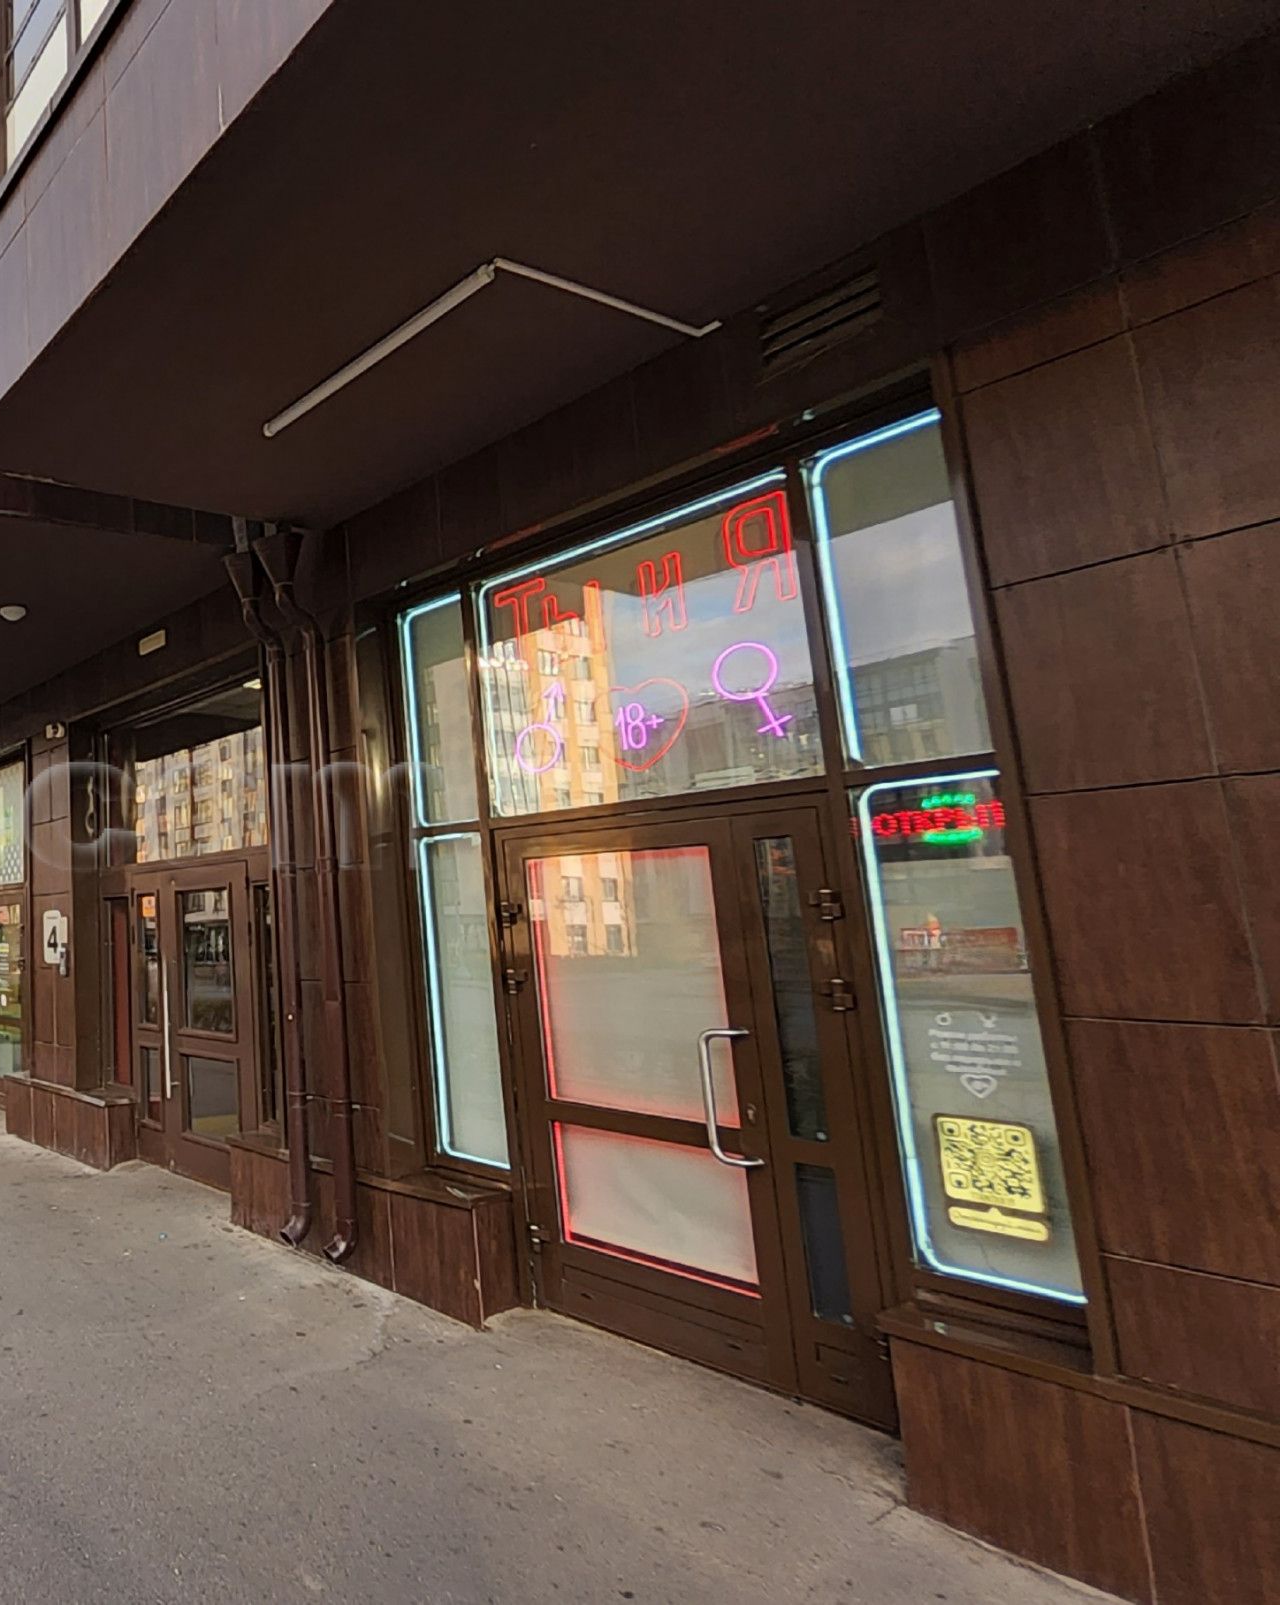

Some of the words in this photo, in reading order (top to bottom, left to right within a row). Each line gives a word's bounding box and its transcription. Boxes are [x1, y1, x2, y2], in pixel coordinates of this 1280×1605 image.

[721, 490, 798, 614] Я
[615, 702, 666, 751] 18+
[47, 925, 59, 954] 4
